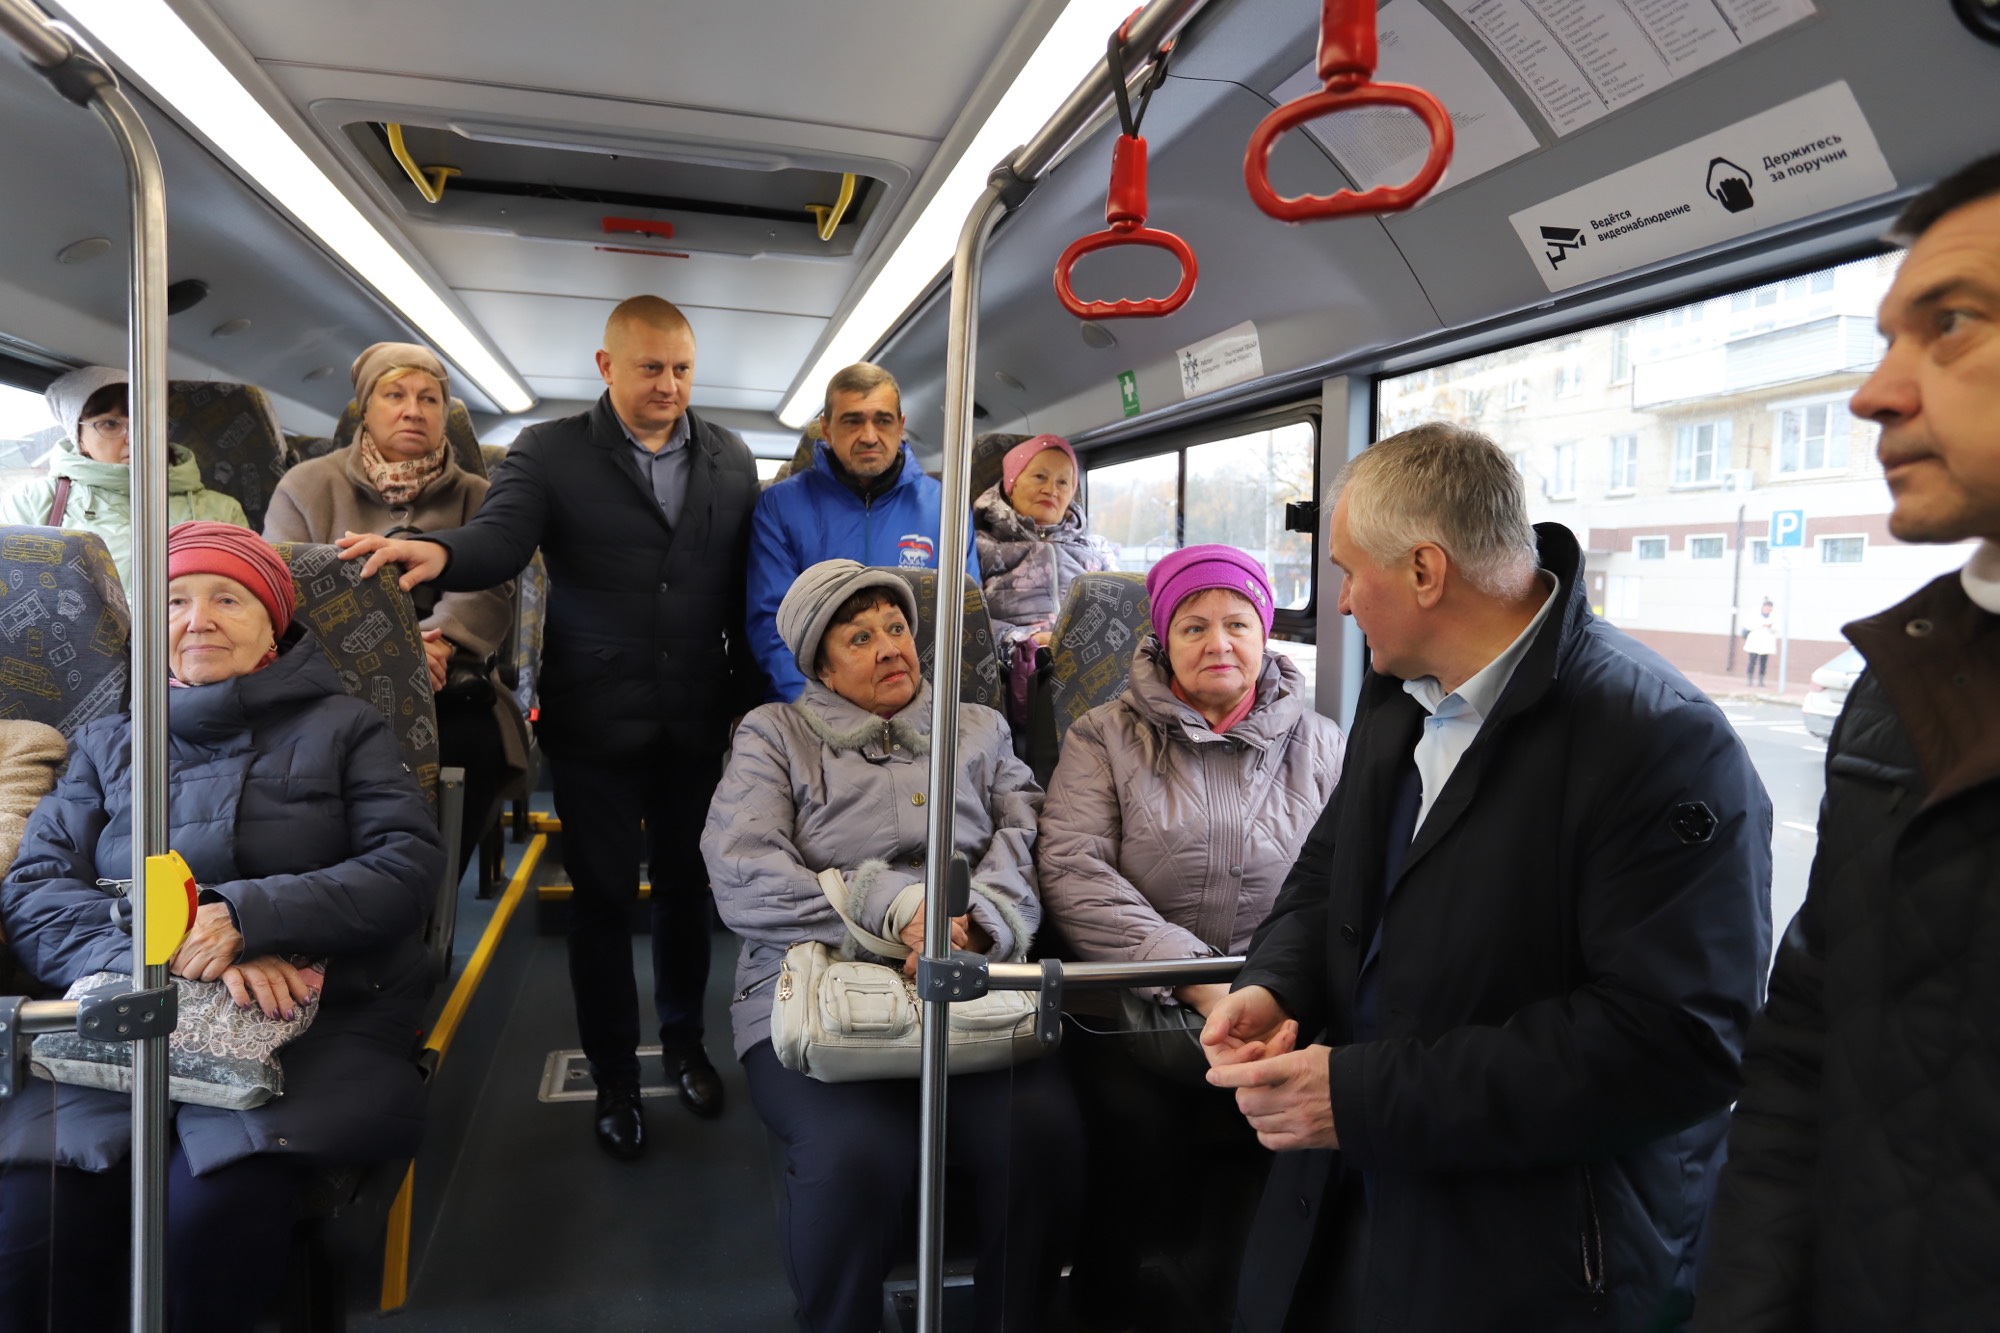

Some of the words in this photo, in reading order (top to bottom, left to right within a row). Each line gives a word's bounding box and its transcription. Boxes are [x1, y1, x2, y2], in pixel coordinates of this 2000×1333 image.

[1762, 135, 1842, 171] Держитесь
[1769, 171, 1786, 183] за
[1787, 149, 1848, 176] поручни
[1590, 210, 1632, 230] Ведётся
[1597, 204, 1691, 242] видеонаблюдение
[1776, 512, 1799, 545] P
